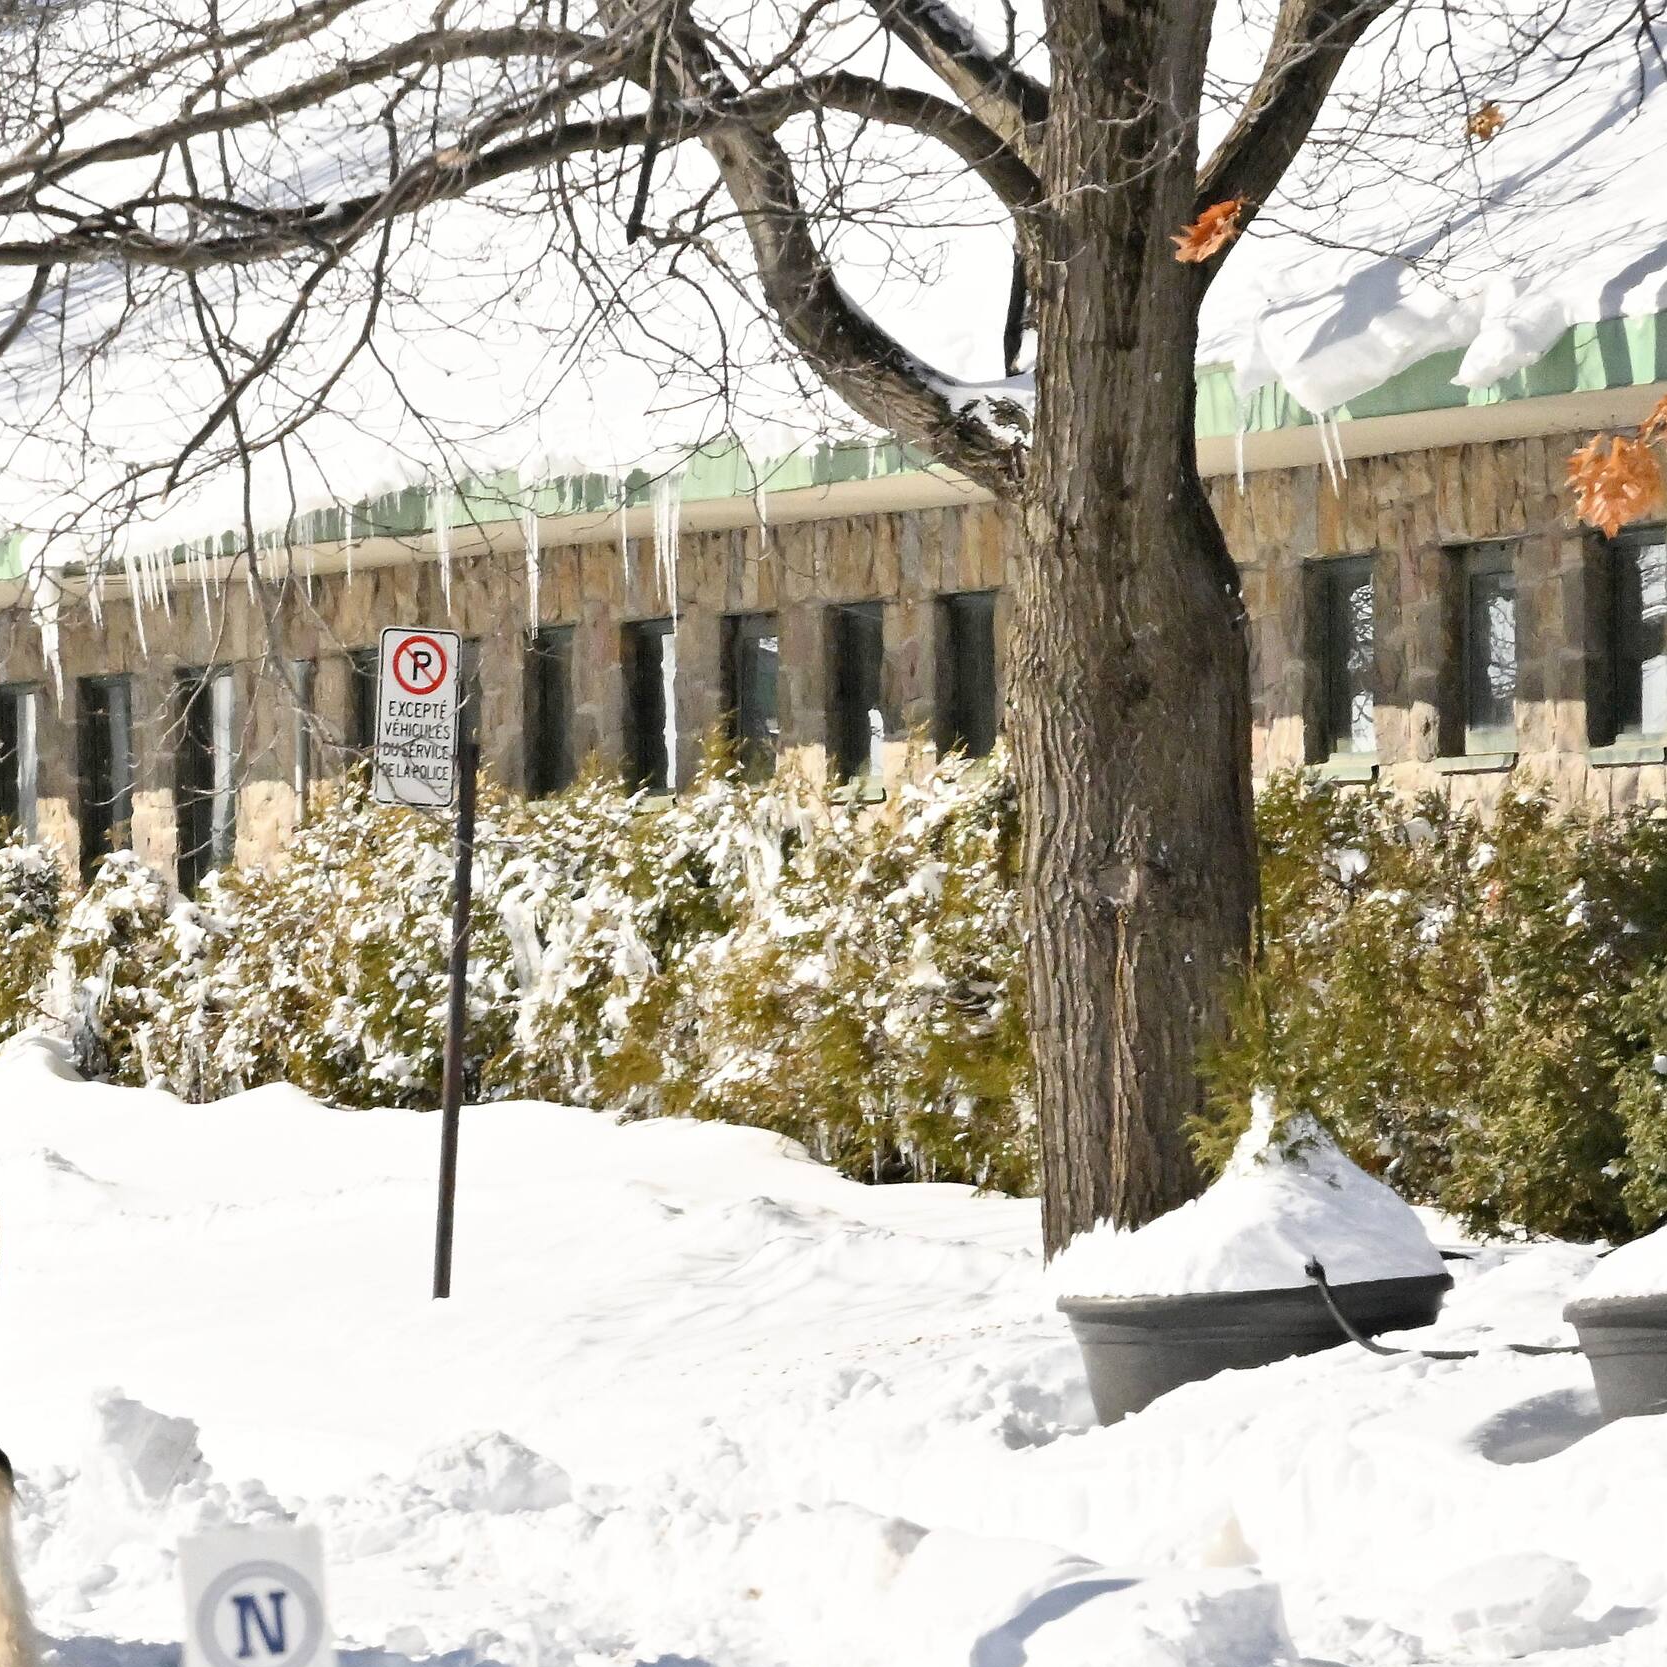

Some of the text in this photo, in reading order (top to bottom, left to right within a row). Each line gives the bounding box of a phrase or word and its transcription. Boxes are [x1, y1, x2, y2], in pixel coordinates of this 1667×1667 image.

[412, 651, 432, 681] P
[388, 700, 447, 719] EXCEPTÉ
[385, 719, 451, 740] VÉHICULES
[383, 742, 449, 760] DU SERVICE
[396, 763, 410, 778] LA
[412, 764, 449, 780] POLICE
[232, 1589, 287, 1660] N
